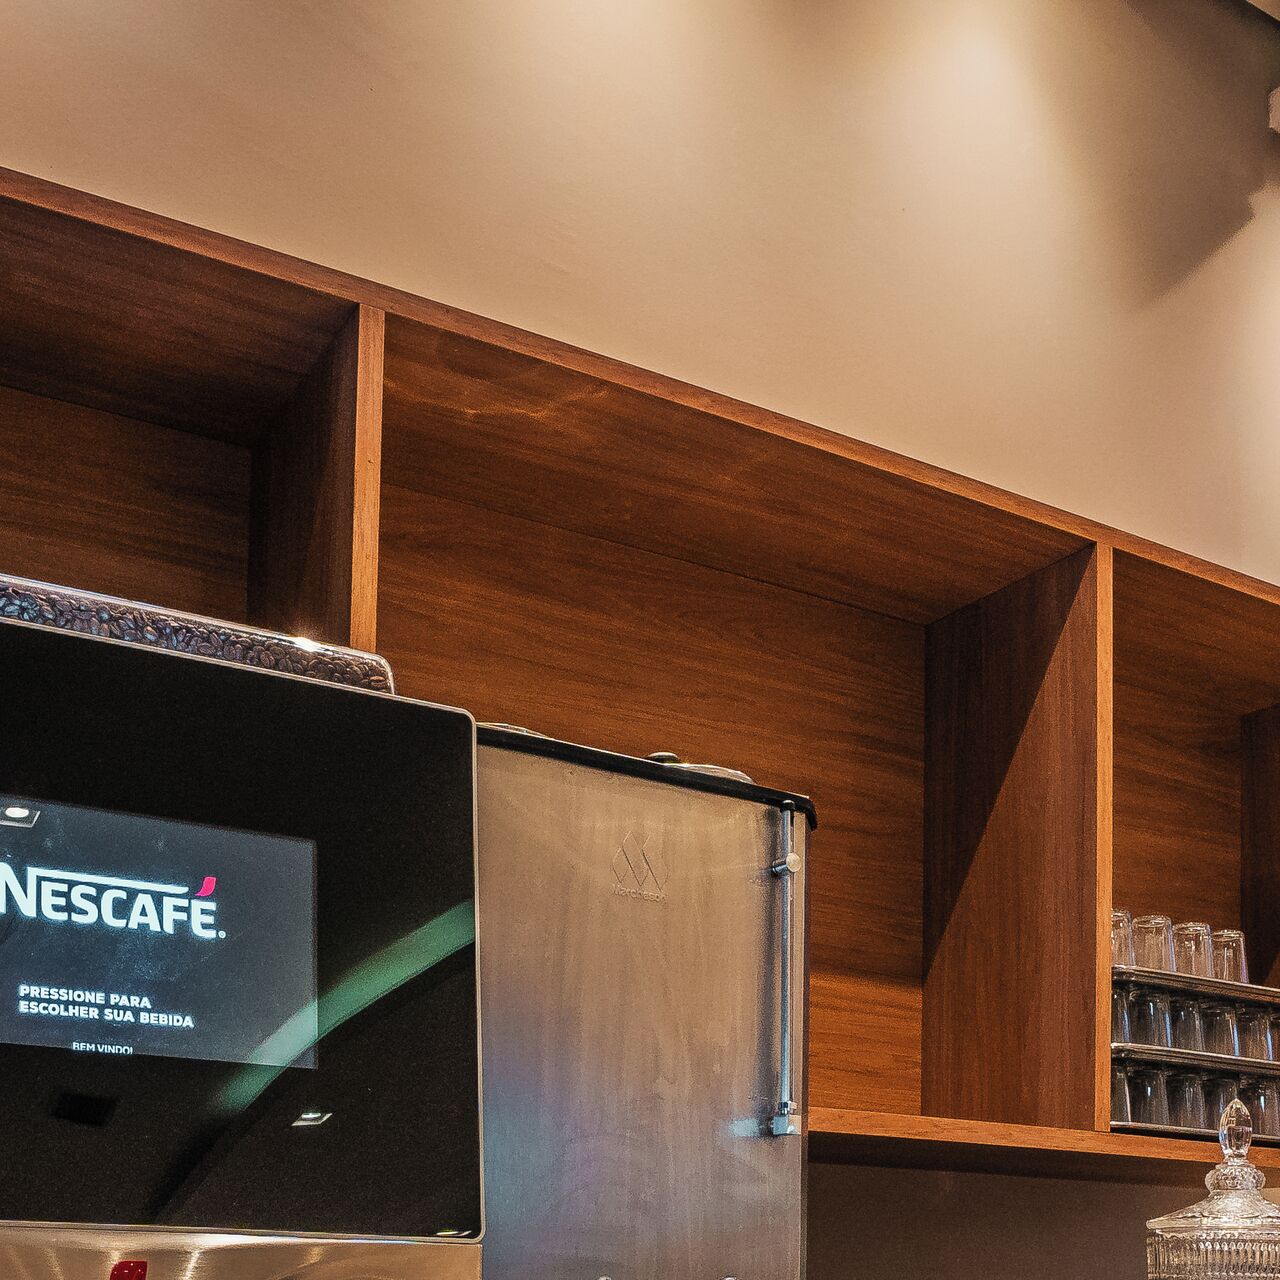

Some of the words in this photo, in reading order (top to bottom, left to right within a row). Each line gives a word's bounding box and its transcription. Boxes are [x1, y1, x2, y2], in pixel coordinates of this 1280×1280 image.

[19, 984, 106, 1005] PRESSIONE
[109, 993, 152, 1009] PARA
[19, 1000, 99, 1019] ESCOLHER
[103, 1008, 135, 1023] SUA
[139, 1011, 195, 1028] BEBIDA
[72, 1042, 96, 1051] BEM
[96, 1044, 134, 1055] VINDO!
